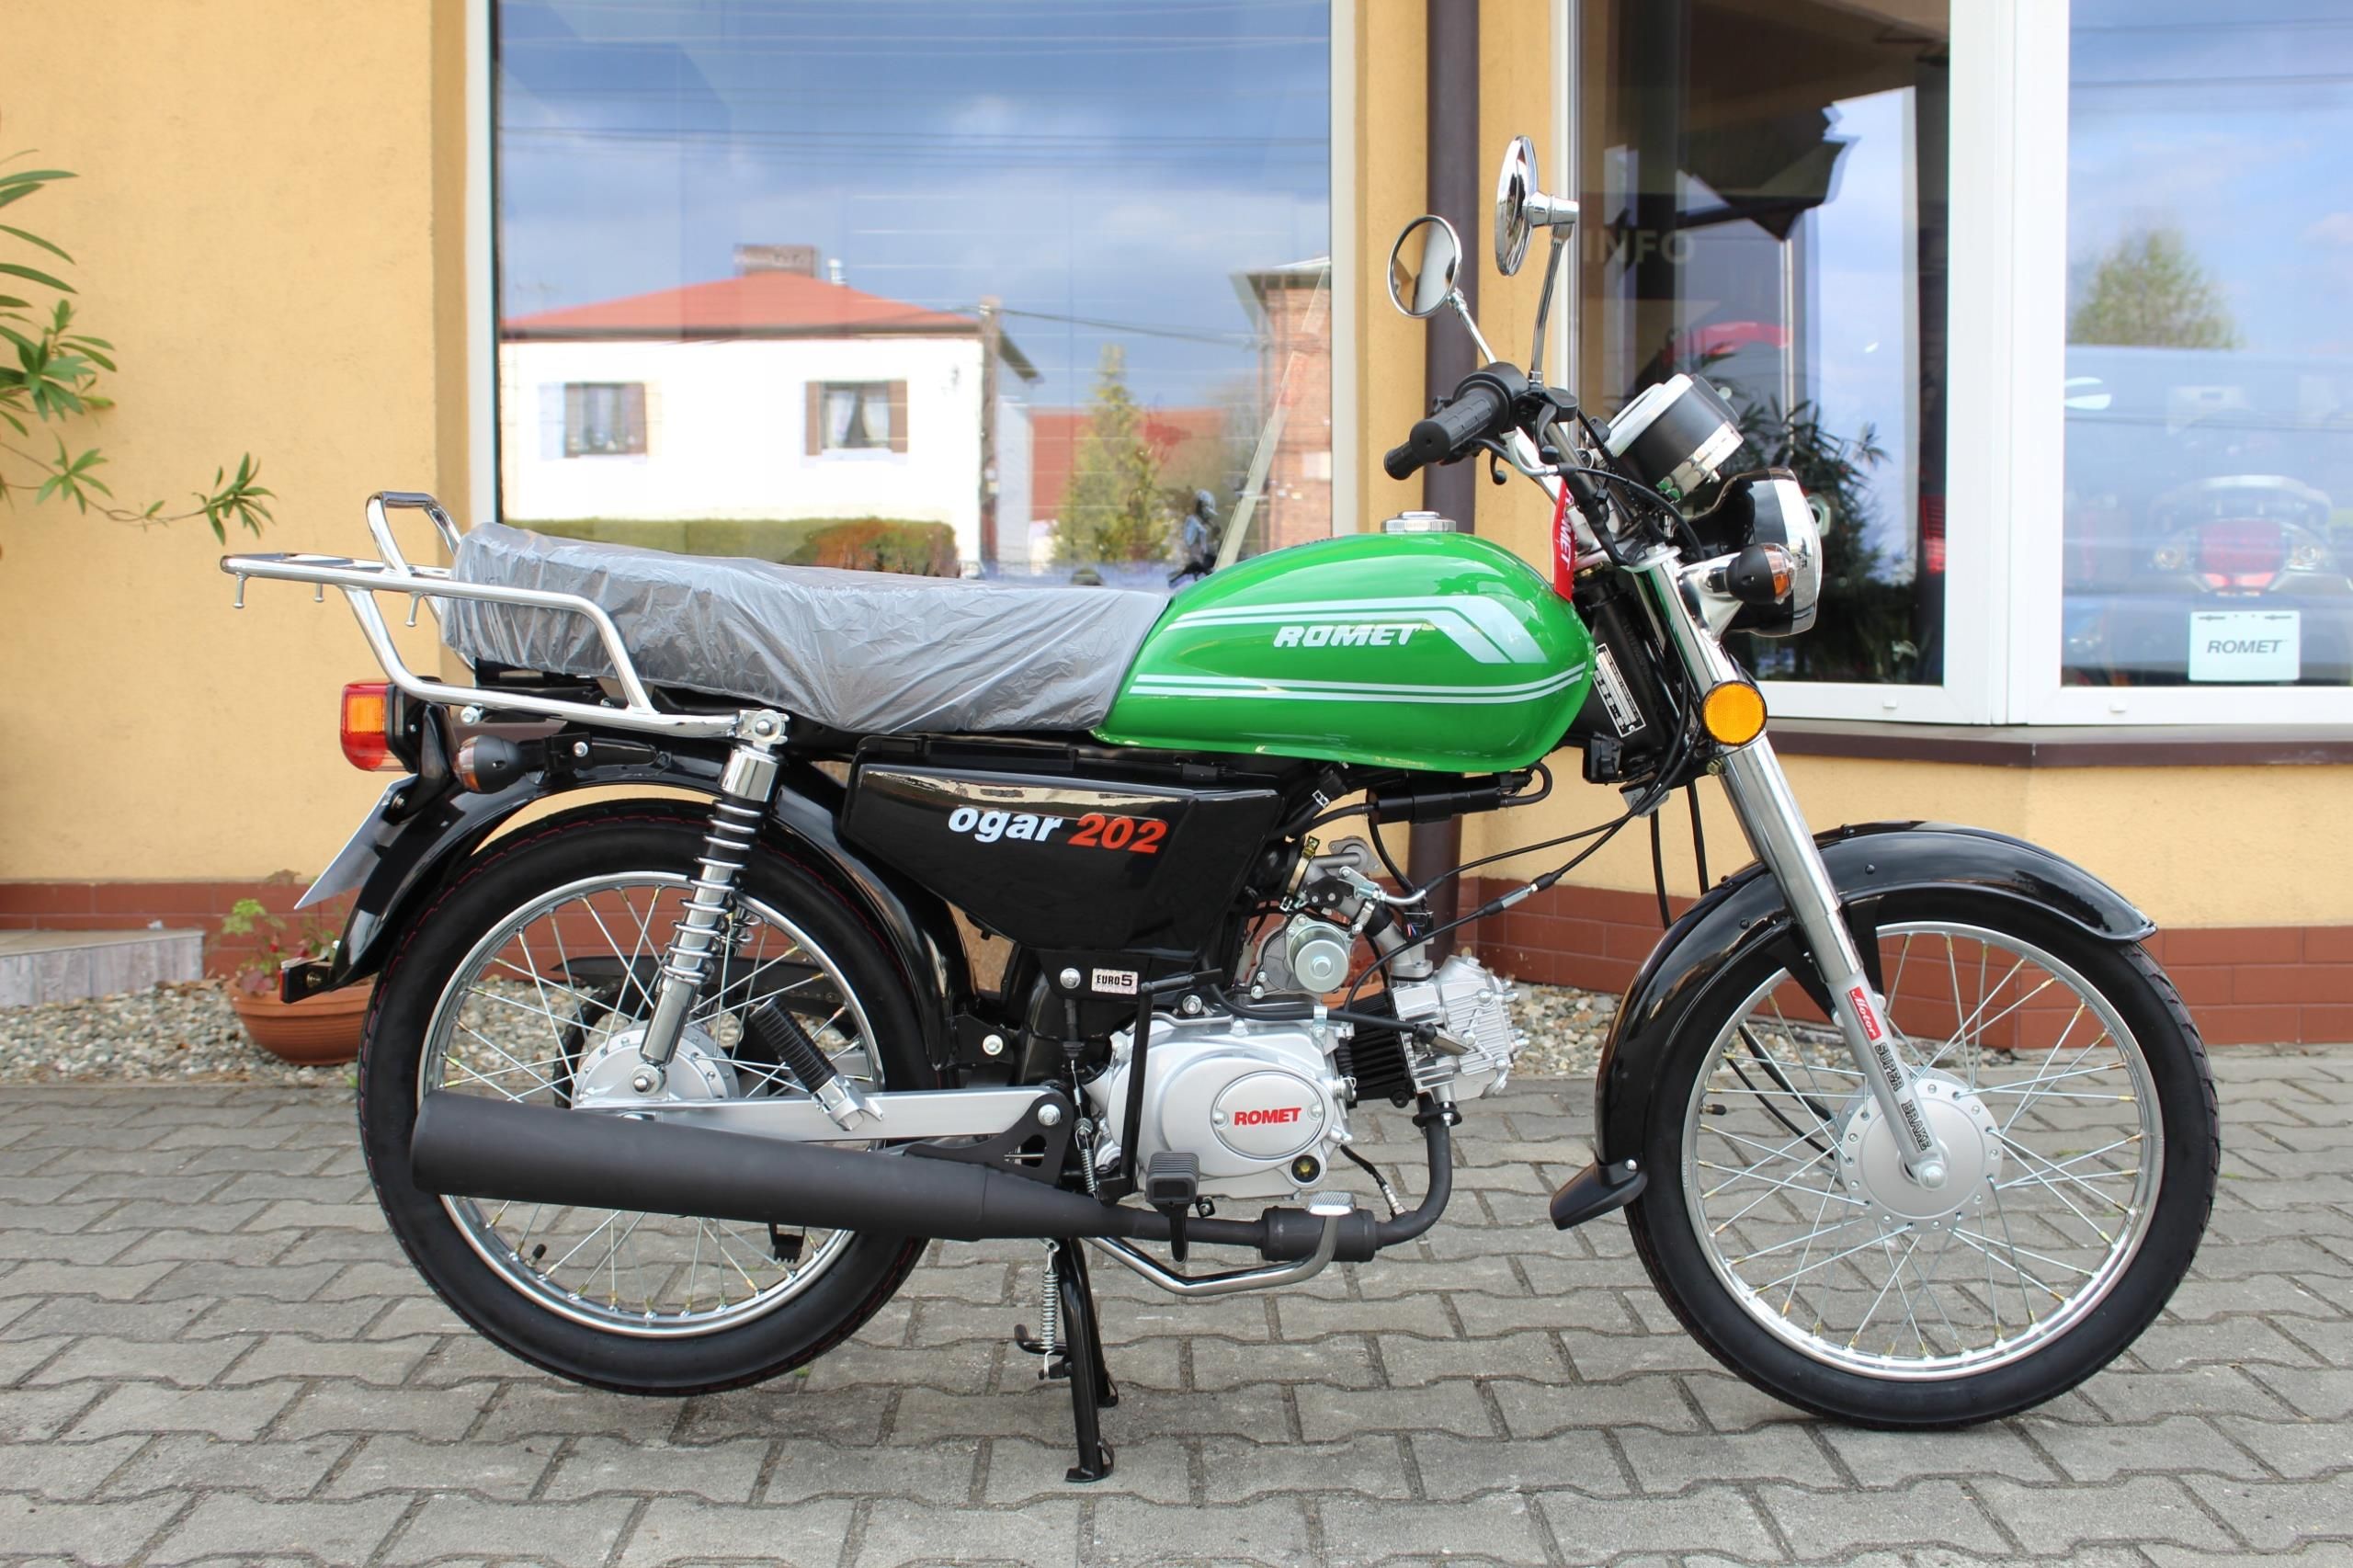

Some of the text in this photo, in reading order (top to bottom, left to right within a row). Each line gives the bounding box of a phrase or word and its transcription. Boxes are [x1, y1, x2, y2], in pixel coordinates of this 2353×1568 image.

[1582, 230, 1697, 265] INFO
[1560, 487, 1576, 572] RMET
[1273, 623, 1424, 647] ROMET
[2207, 640, 2284, 653] ROMET
[948, 807, 1169, 854] ogar 202
[1874, 1042, 1933, 1151] SUPER BRAKE
[1233, 1107, 1302, 1126] ROMET
